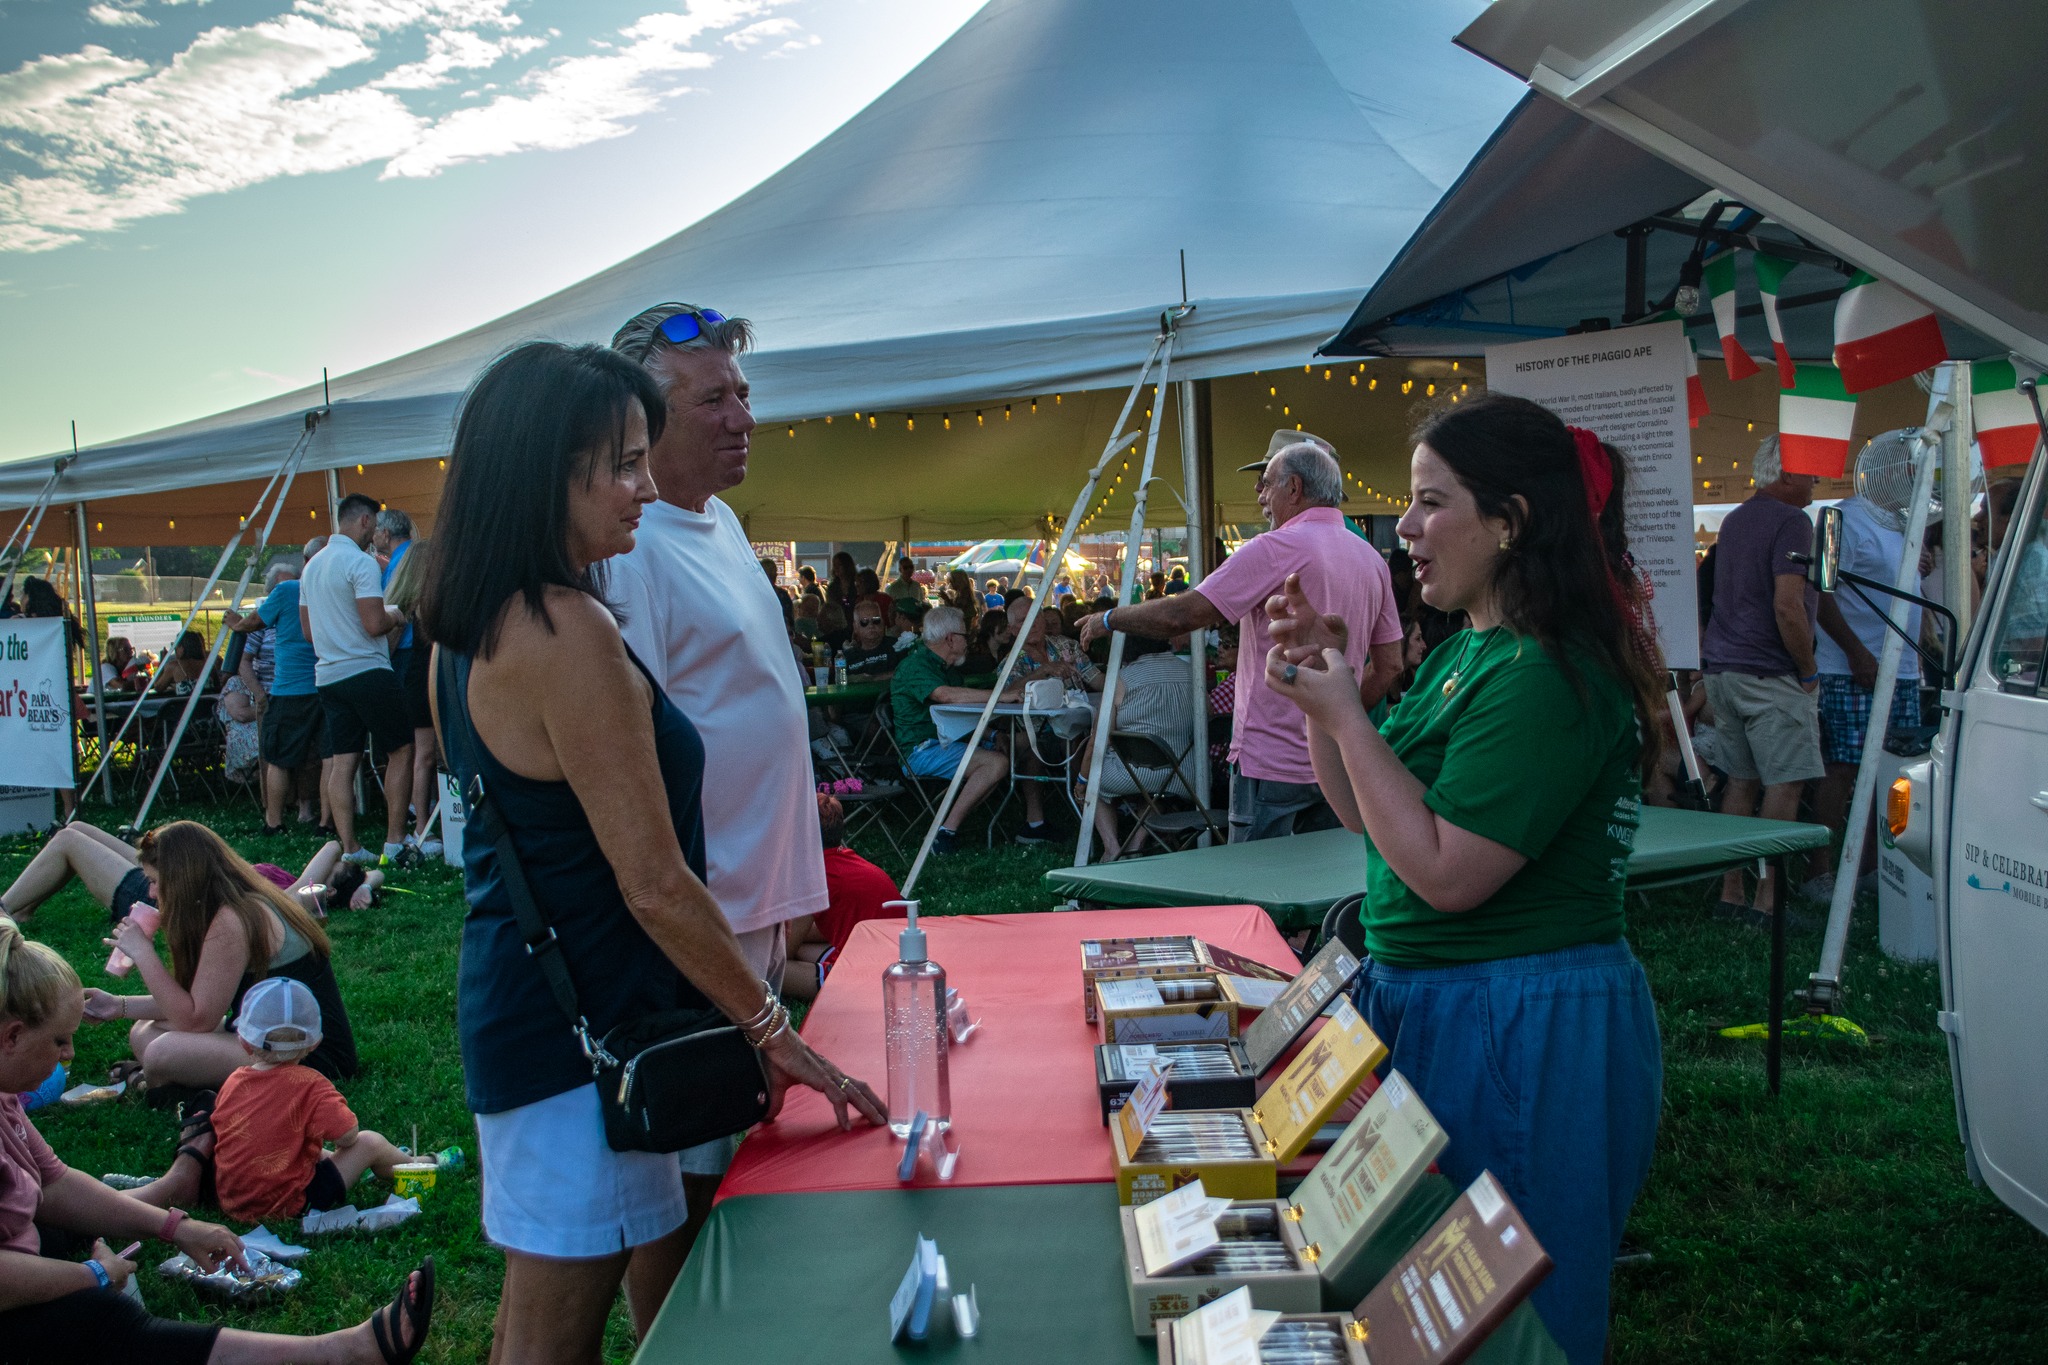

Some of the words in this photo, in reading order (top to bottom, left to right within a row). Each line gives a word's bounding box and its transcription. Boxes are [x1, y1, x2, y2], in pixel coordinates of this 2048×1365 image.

[1515, 359, 1555, 373] HISTORY
[1556, 357, 1570, 368] OF
[1571, 354, 1590, 366] THE
[1592, 348, 1631, 363] PIAGGIO
[1633, 346, 1652, 358] APE
[1539, 396, 1556, 404] World
[1558, 395, 1570, 403] War
[1578, 393, 1594, 401] most
[1595, 390, 1618, 399] Italians,
[1620, 387, 1637, 397] badly
[1638, 385, 1664, 395] affected
[1665, 383, 1673, 393] by
[1563, 405, 1584, 414] modes
[1585, 403, 1592, 412] of
[1593, 401, 1623, 412] transport,
[1624, 399, 1636, 407] and
[1649, 394, 1675, 404] financial
[1582, 411, 1622, 422] four-wheeled
[1624, 409, 1650, 419] vehicles.
[1659, 405, 1674, 415] 1947
[1610, 421, 1636, 432] designer
[1637, 418, 1668, 428] Corradino
[1611, 432, 1636, 443] building
[1641, 429, 1655, 440] light
[1656, 428, 1673, 438] three
[1638, 440, 1674, 450] economical
[1638, 454, 1650, 462] with
[1652, 452, 1672, 460] Enrico
[1642, 499, 1655, 508] two
[1656, 498, 1679, 507] wheels
[1649, 512, 1660, 520] top
[1662, 509, 1669, 518] of
[1670, 510, 1681, 518] the
[1639, 523, 1663, 531] adverts
[1664, 522, 1676, 530] the
[1646, 534, 1674, 544] TriVespa.
[755, 546, 785, 558] CAKES
[1649, 557, 1665, 566] since
[1665, 557, 1674, 565] its
[1653, 568, 1681, 576] different
[136, 614, 172, 622] FOUNDERS
[7, 632, 28, 661] the
[31, 693, 51, 707] PAPA
[28, 708, 60, 723] BEAR'S
[1965, 843, 1980, 863] SIP
[1982, 849, 1989, 868] &
[2012, 886, 2041, 908] MOBILE
